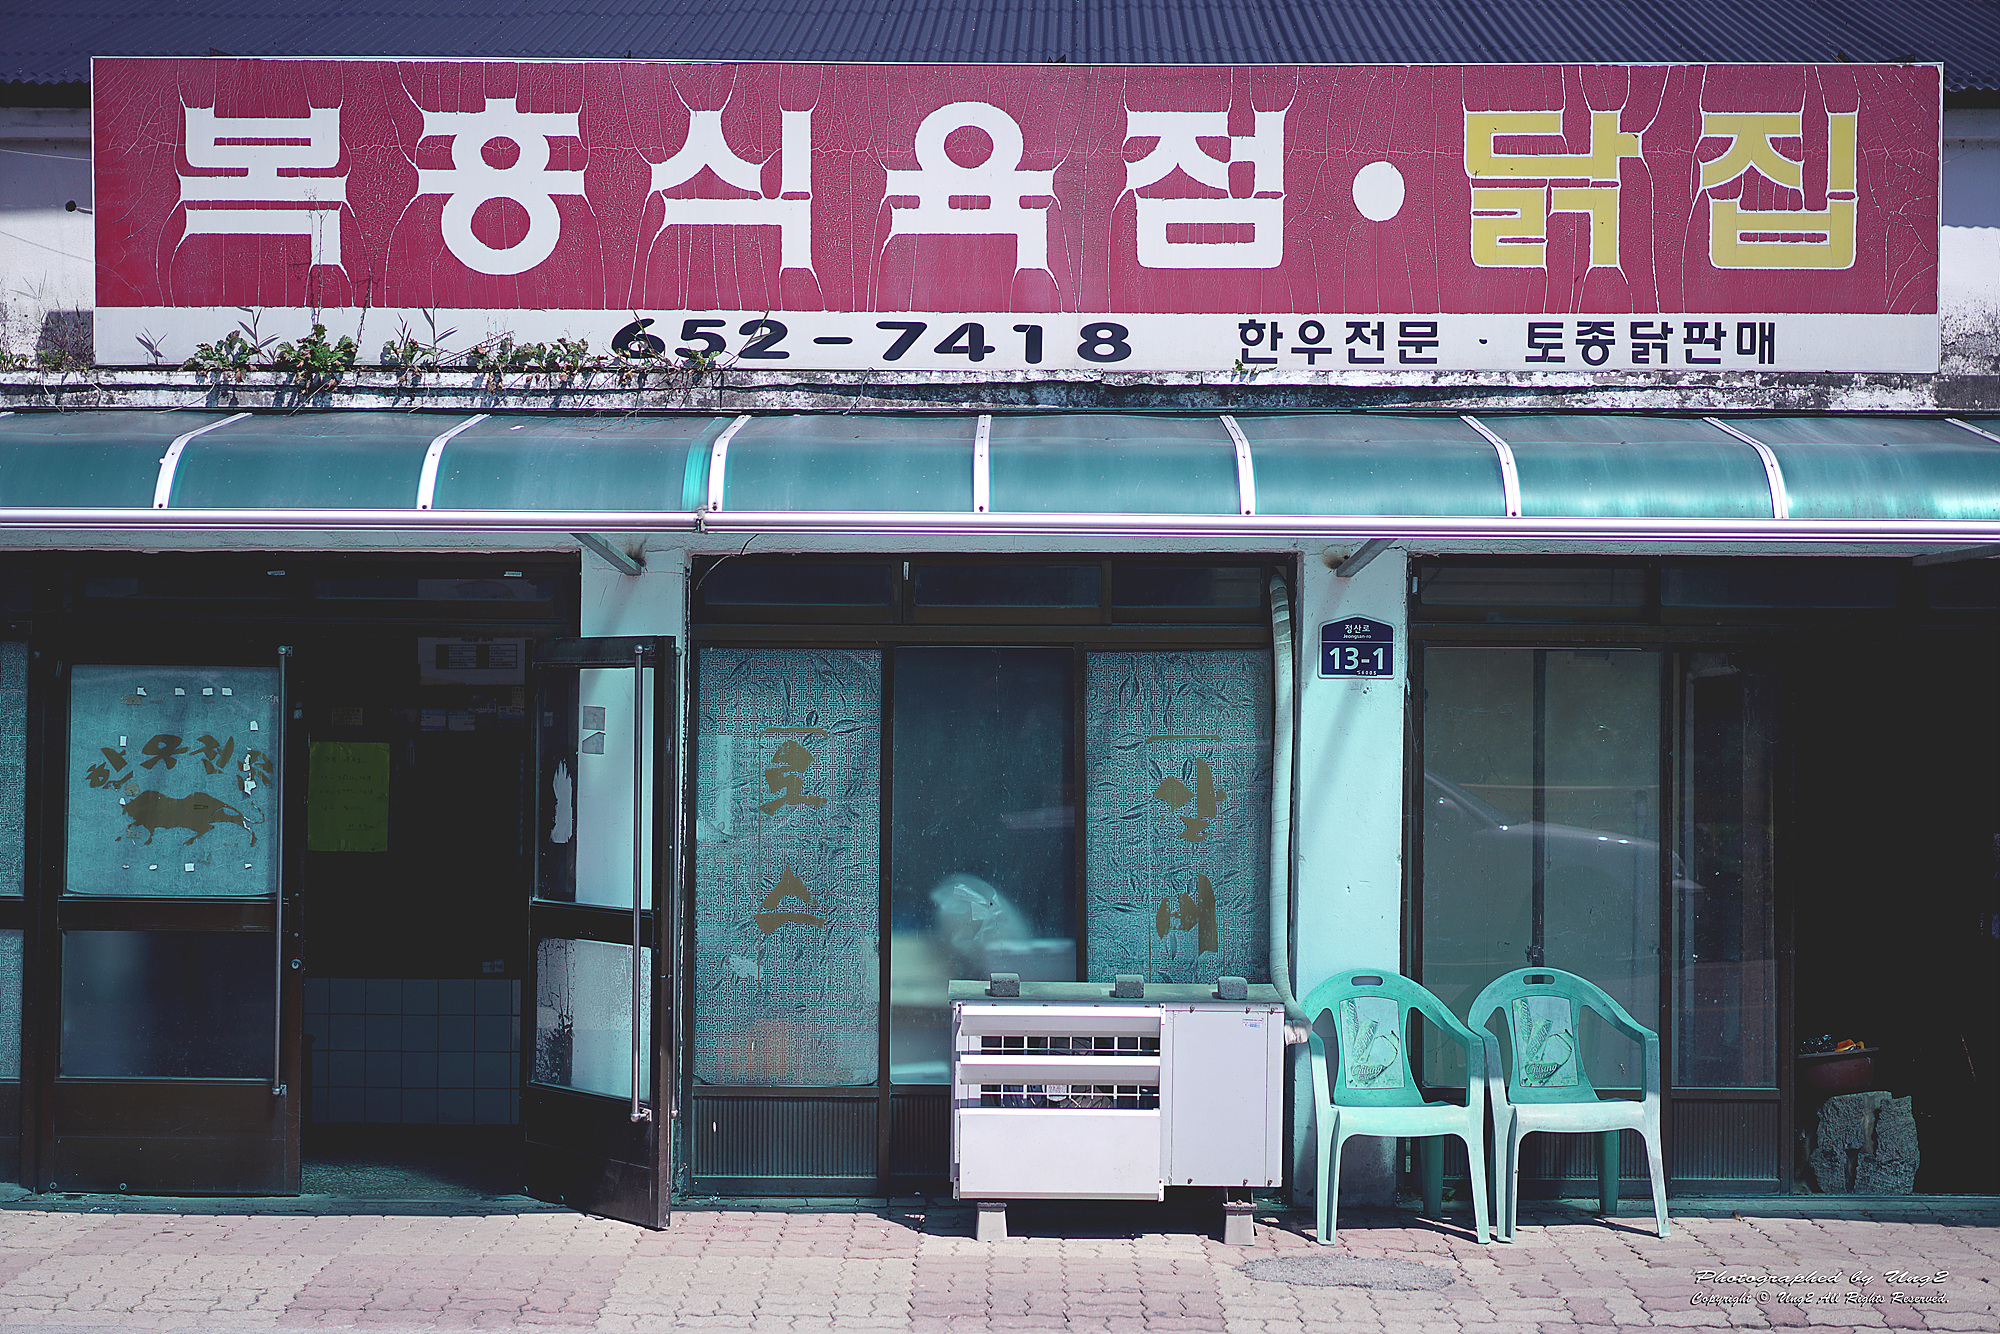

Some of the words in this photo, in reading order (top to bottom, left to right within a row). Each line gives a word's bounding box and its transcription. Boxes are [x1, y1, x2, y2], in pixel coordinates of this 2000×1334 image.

[180, 98, 1285, 275] 복흥식육점
[1464, 110, 1858, 270] 닭집
[1238, 319, 1439, 365] 한우전문
[1525, 320, 1777, 366] 토종닭판매
[1344, 624, 1371, 634] 정산로
[1329, 647, 1384, 670] 13-1
